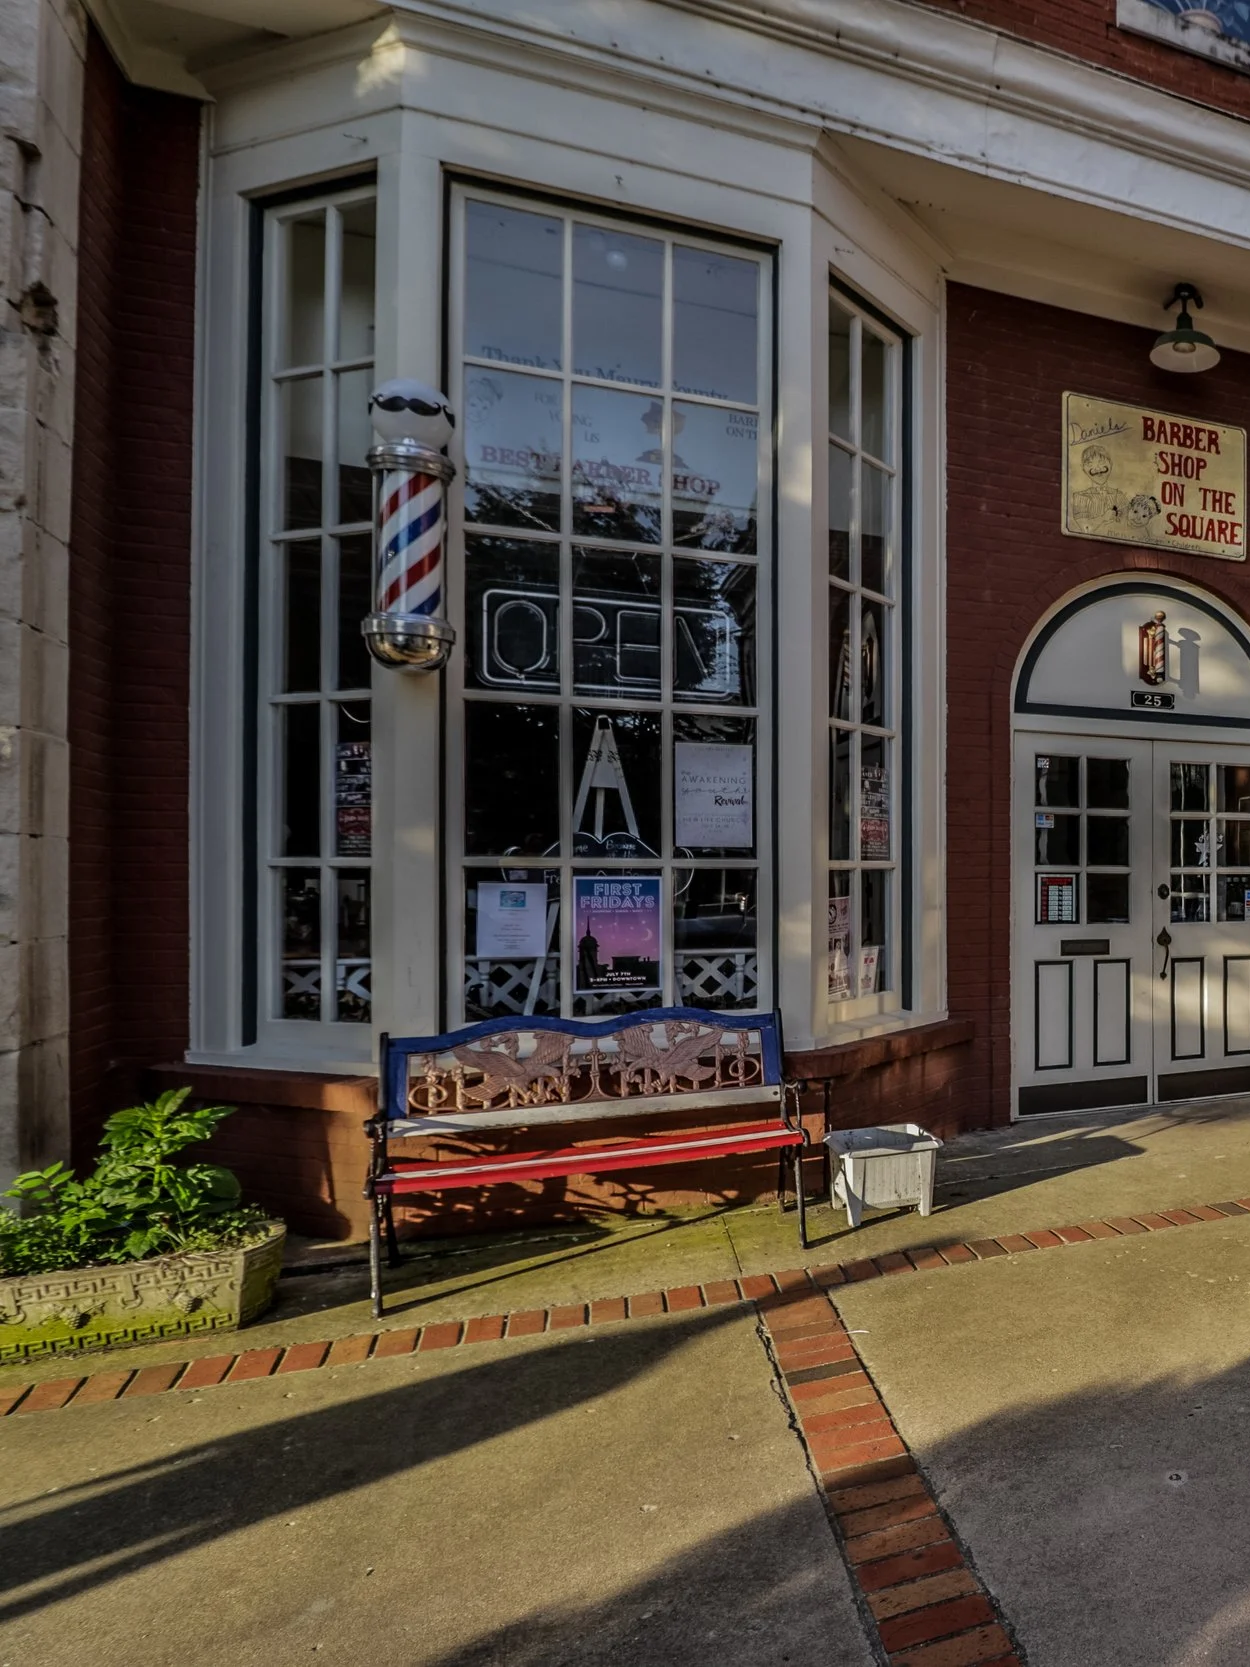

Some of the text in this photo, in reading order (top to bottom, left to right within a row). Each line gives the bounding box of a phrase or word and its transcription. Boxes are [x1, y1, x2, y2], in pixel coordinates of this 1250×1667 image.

[584, 431, 600, 444] US
[1142, 416, 1221, 456] BARBER
[480, 445, 543, 470] BEST
[1157, 451, 1208, 481] SHOP
[1161, 481, 1236, 516] ON THE
[1165, 512, 1243, 546] SQUARE
[493, 600, 720, 686] OPEN
[1144, 694, 1162, 707] 25
[681, 776, 747, 785] AWAKENING
[714, 795, 749, 807] Revival
[594, 883, 643, 896] FIRST
[580, 895, 655, 909] FRIDAYS
